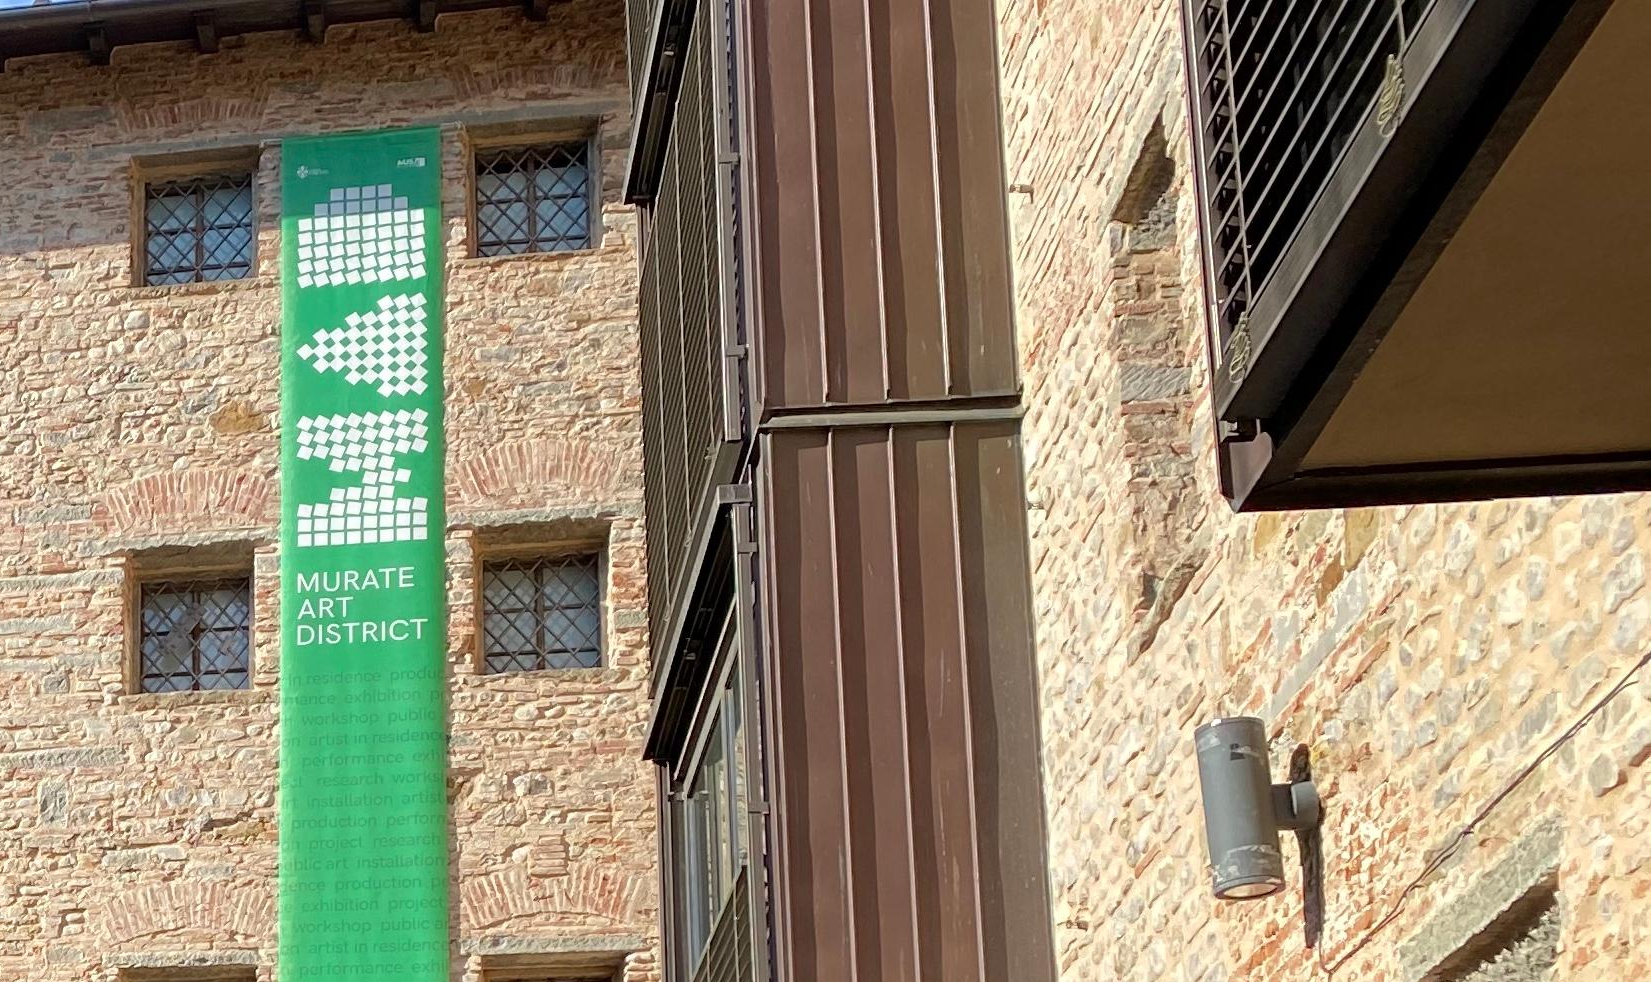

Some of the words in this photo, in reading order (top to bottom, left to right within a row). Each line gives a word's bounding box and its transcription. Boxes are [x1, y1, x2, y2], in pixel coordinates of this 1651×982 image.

[297, 566, 415, 594] MURATE
[297, 596, 354, 619] ART
[297, 618, 428, 646] DISTRICT
